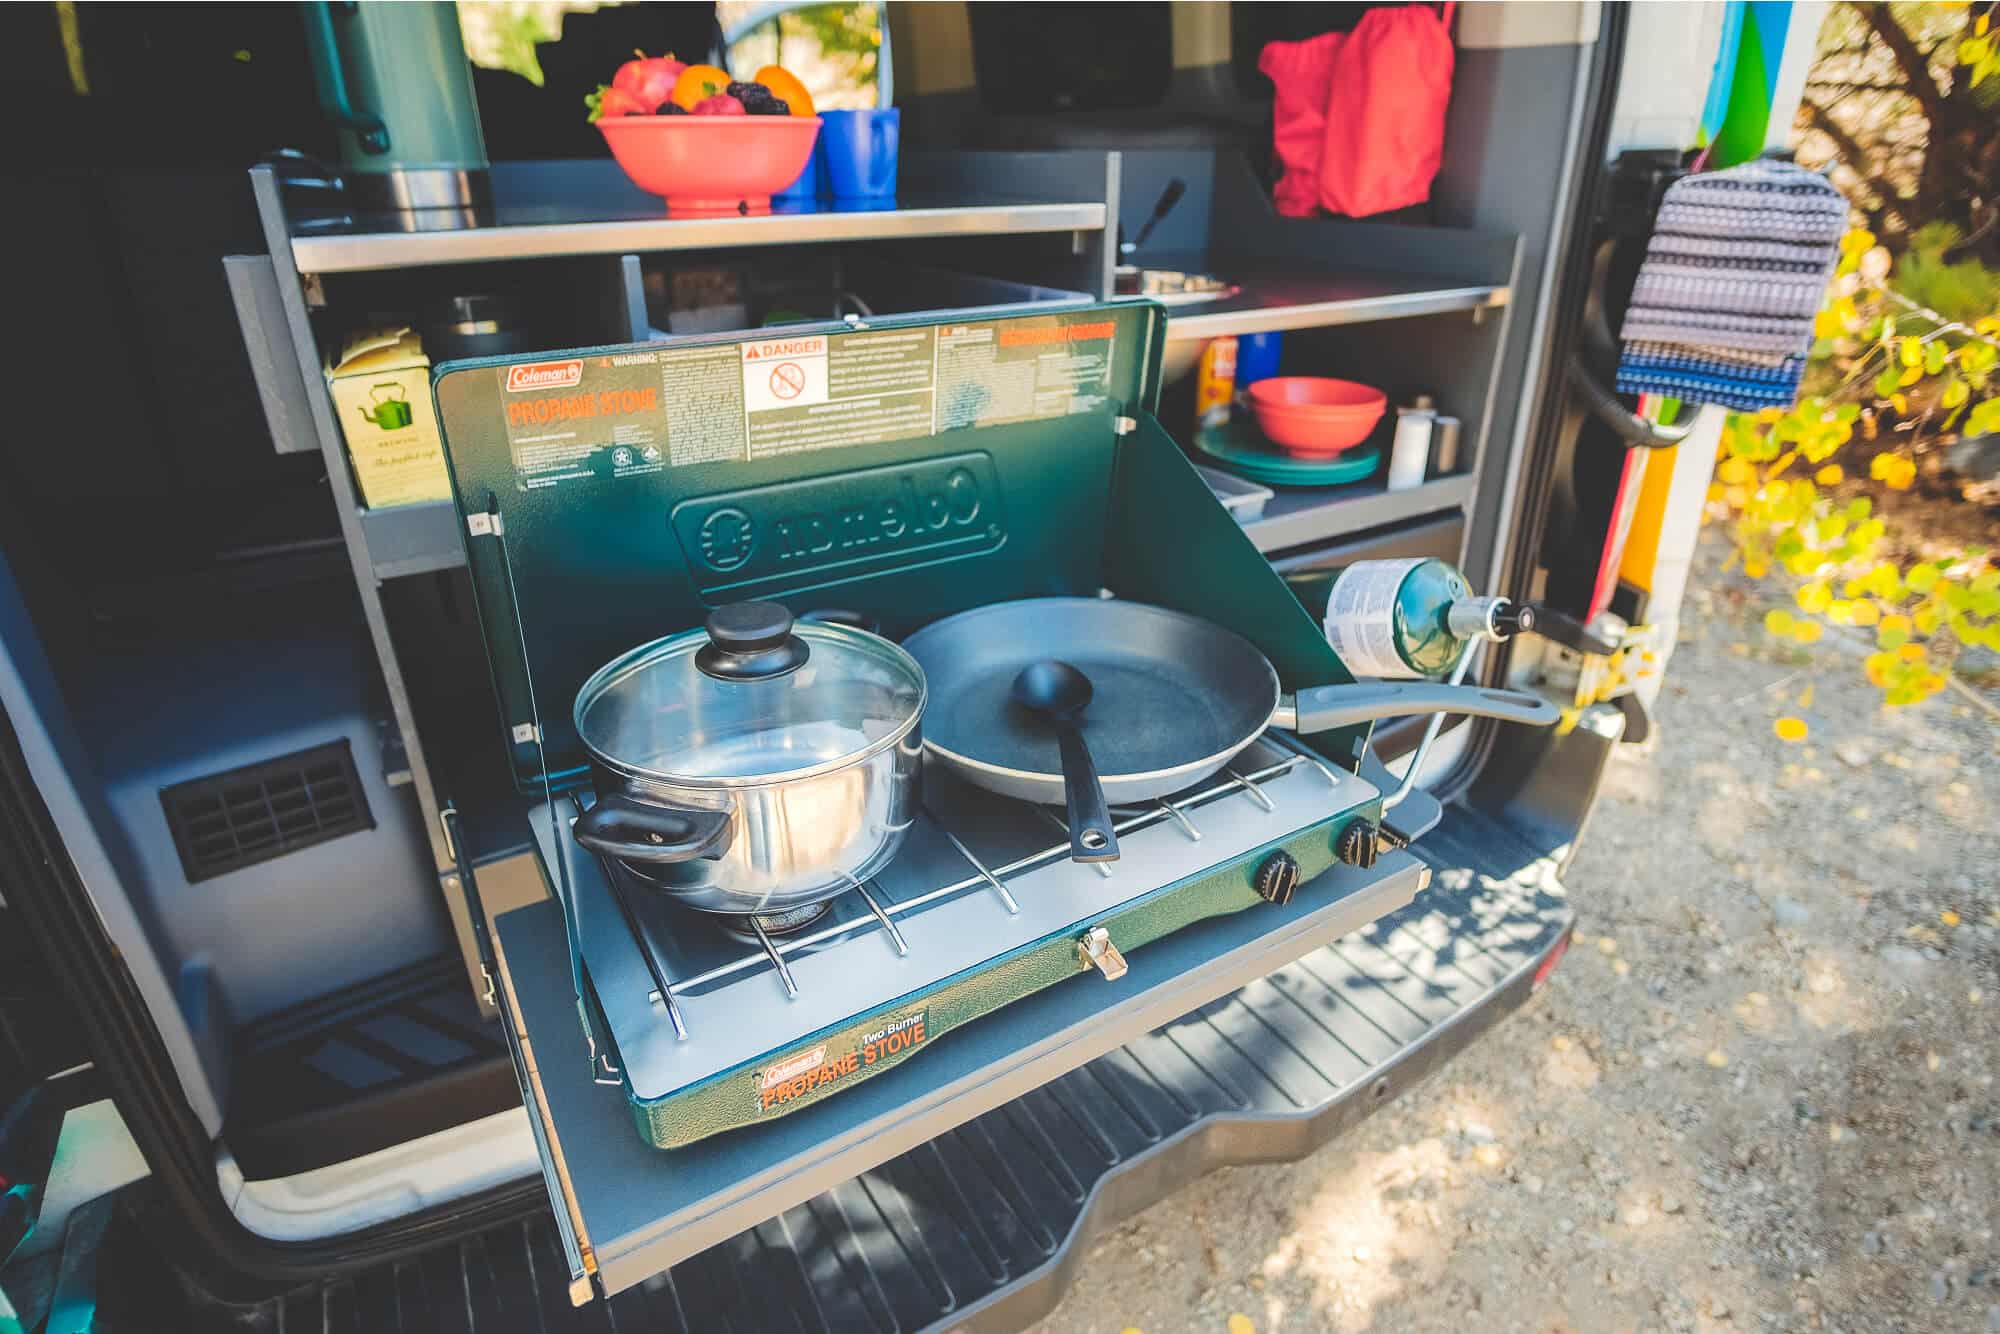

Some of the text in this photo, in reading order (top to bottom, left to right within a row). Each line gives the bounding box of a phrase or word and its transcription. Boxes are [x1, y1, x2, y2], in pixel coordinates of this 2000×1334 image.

[763, 340, 822, 357] DANGER
[513, 367, 568, 385] Coleman
[509, 387, 657, 426] PROPANE STOVE
[862, 1012, 925, 1045] Two Burner
[761, 1022, 927, 1112] PROPANE STOVE
